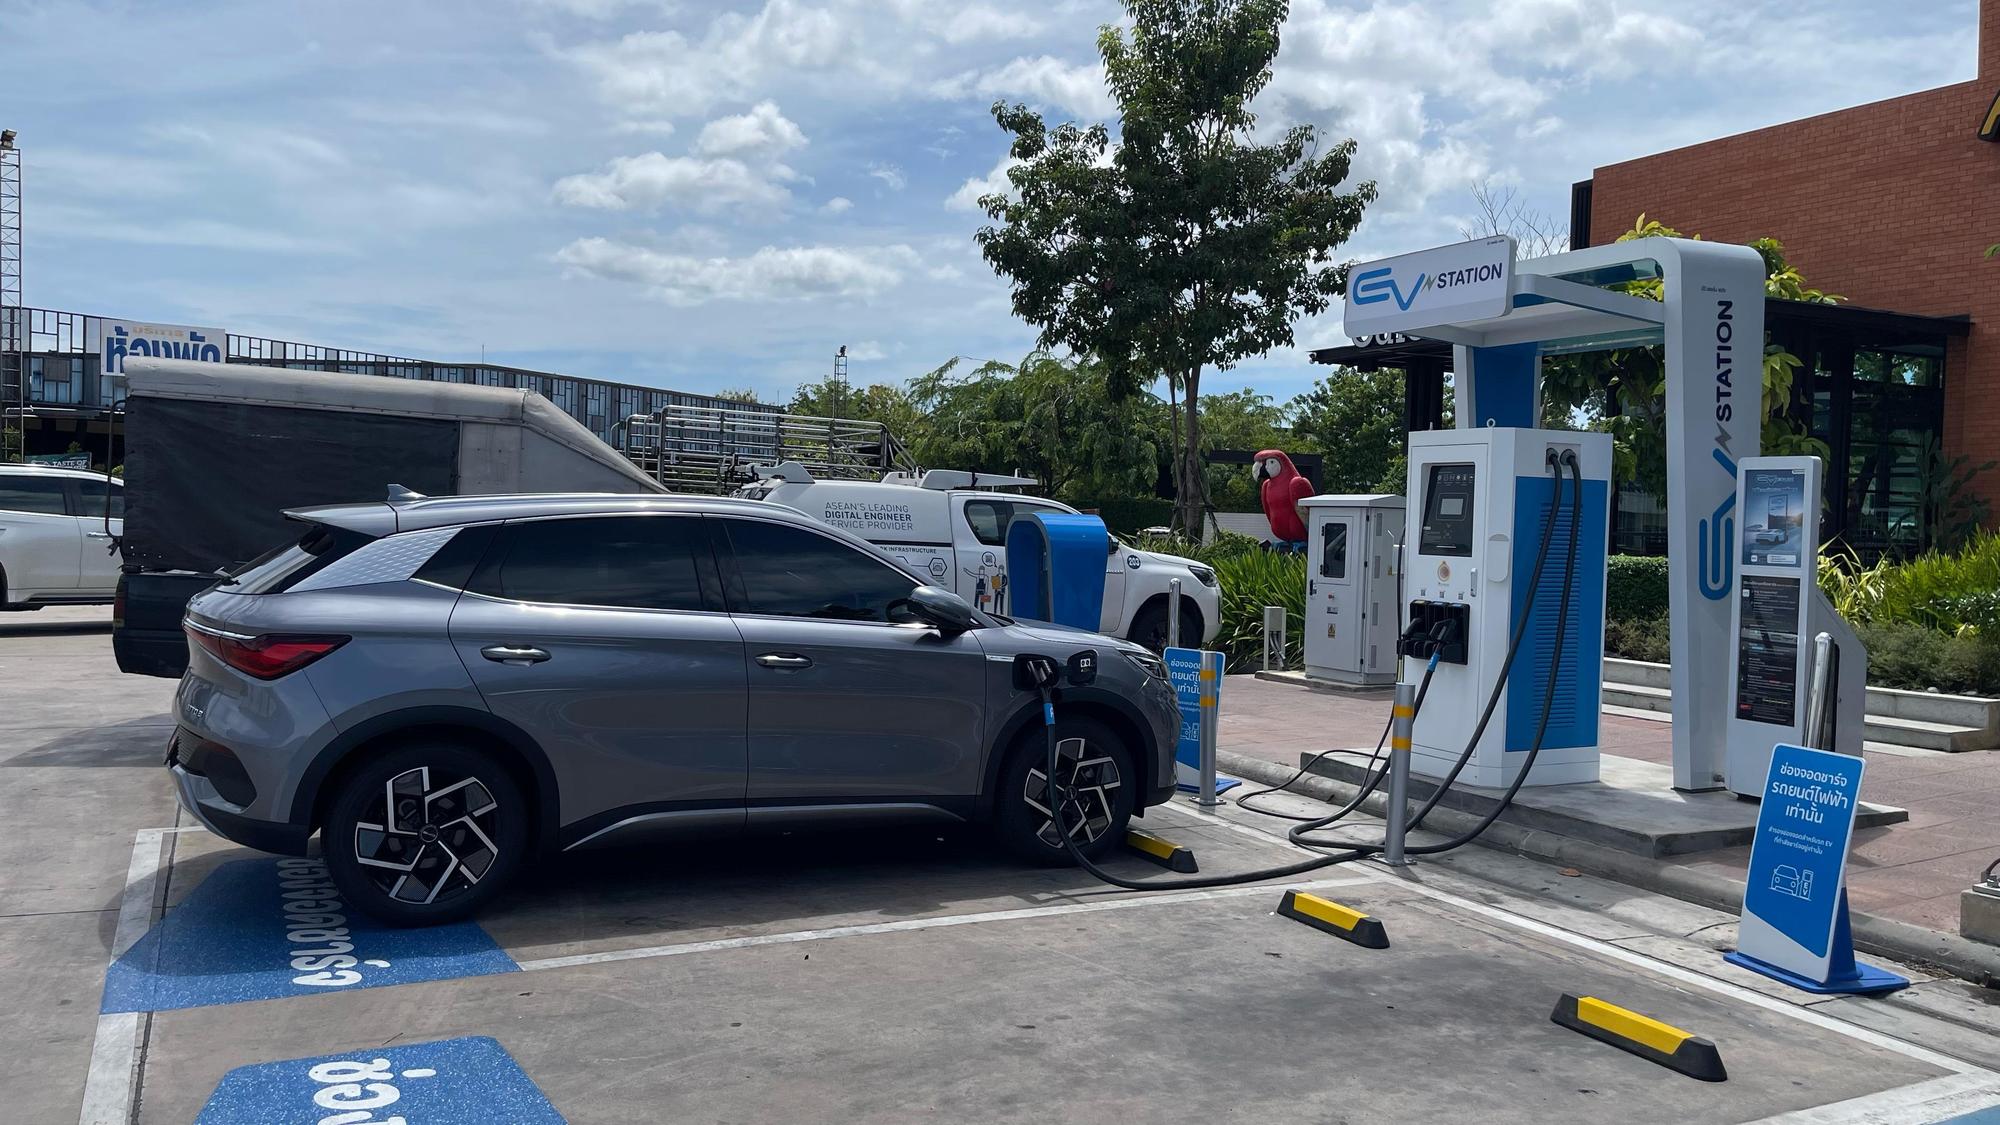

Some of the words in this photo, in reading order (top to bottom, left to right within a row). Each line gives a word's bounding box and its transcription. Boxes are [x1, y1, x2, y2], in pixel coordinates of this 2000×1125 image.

[1353, 267, 1425, 311] EV
[1437, 263, 1503, 289] STATION
[1715, 300, 1733, 422] STATION
[825, 501, 866, 511] ASEAN'S
[868, 503, 909, 513] LEADING
[825, 510, 862, 520] DIGITAL
[864, 511, 912, 522] ENGINEER
[867, 521, 913, 531] PROVIDER
[888, 546, 937, 554] INFRASTRUCTURE
[1780, 762, 1848, 787] ช่องจอดชาร์จ
[1771, 781, 1848, 809] รถยนต์ไฟฟ้า
[1785, 802, 1824, 824] เท่านั้น
